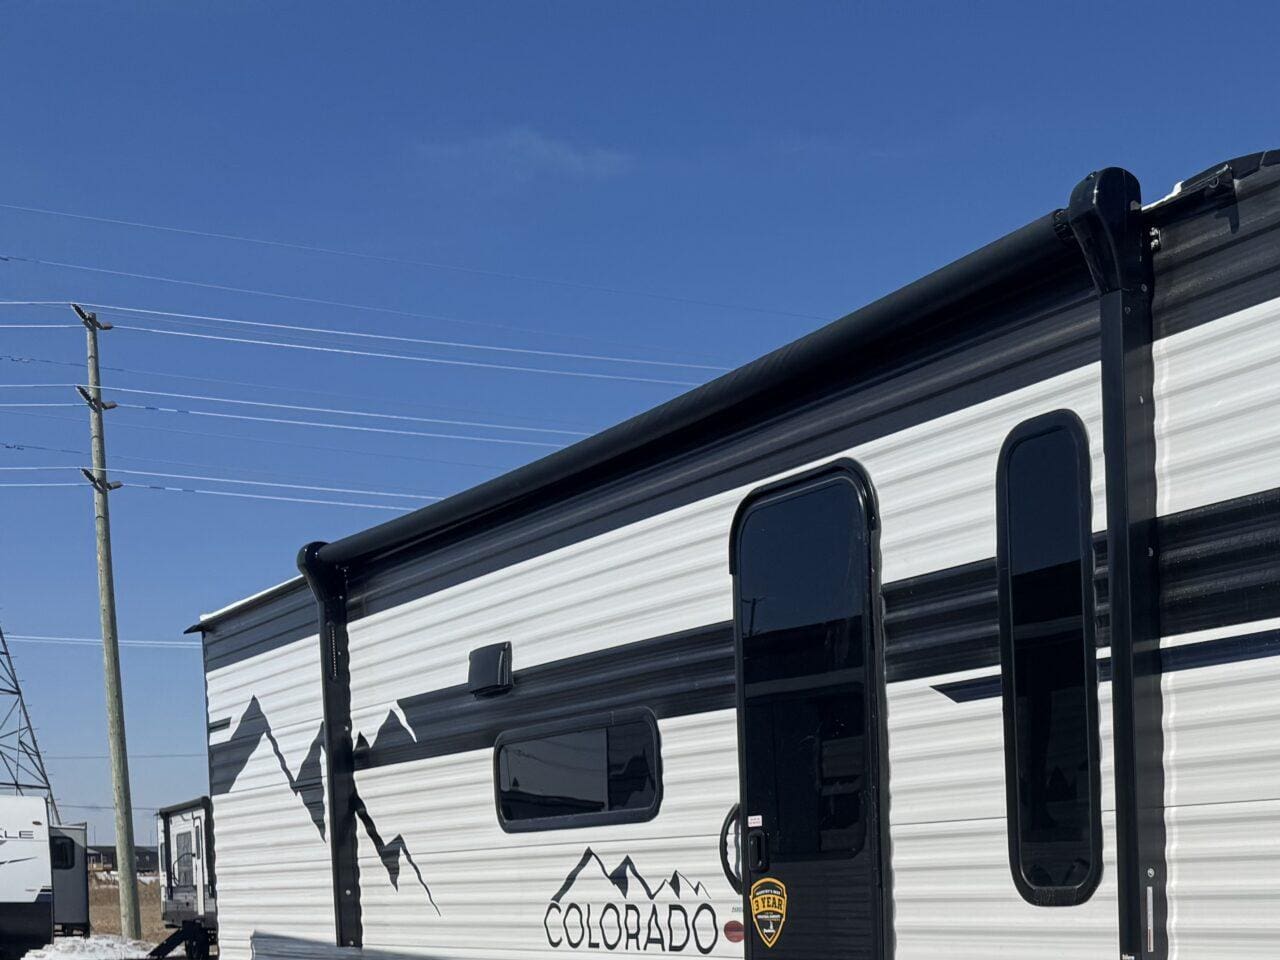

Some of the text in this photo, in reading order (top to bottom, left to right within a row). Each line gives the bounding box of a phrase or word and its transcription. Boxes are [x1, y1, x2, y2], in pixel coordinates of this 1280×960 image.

[0, 829, 35, 840] LE
[754, 899, 760, 911] 3
[761, 896, 784, 911] YEAR
[544, 903, 719, 955] COLORADO
